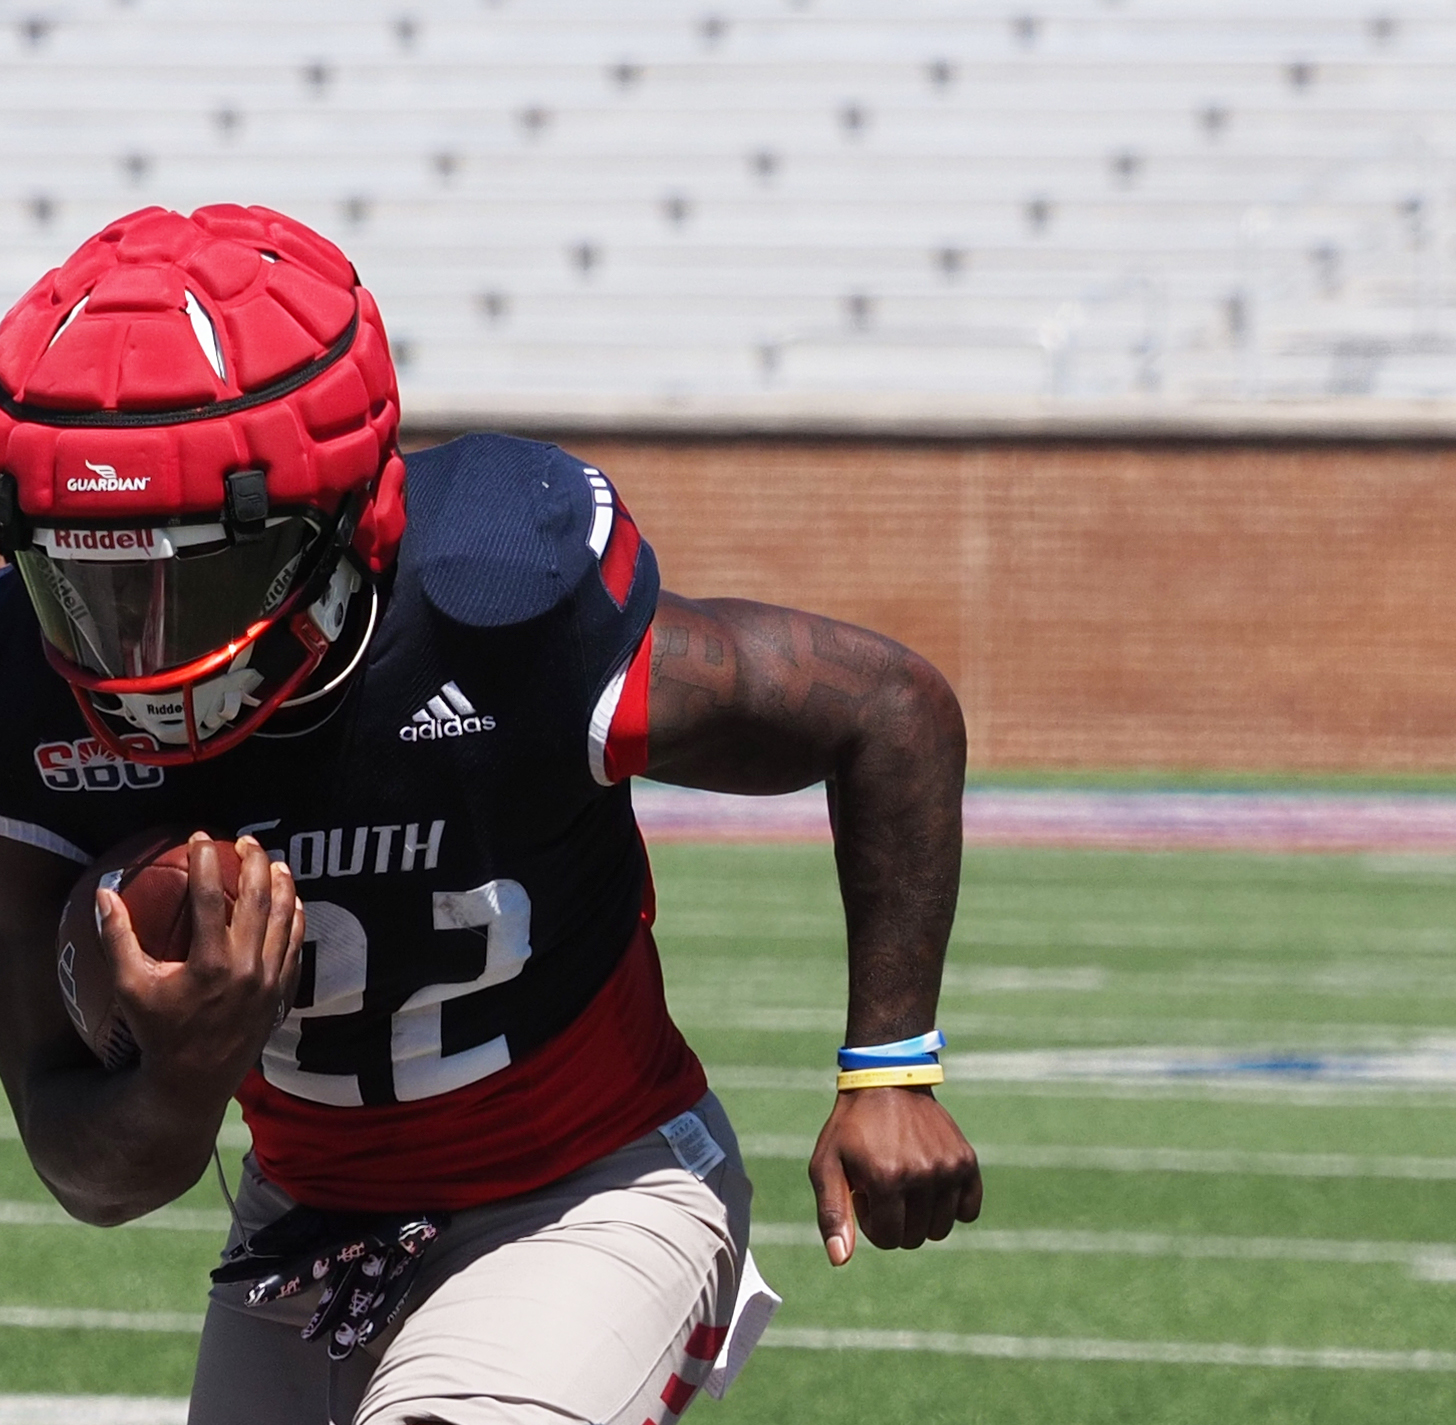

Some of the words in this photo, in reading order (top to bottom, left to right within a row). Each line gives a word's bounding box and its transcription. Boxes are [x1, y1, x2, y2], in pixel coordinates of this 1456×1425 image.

[66, 477, 147, 492] GUARDIAN
[54, 528, 155, 550] Riddell
[399, 711, 497, 743] adidas
[261, 879, 533, 1108] 22
